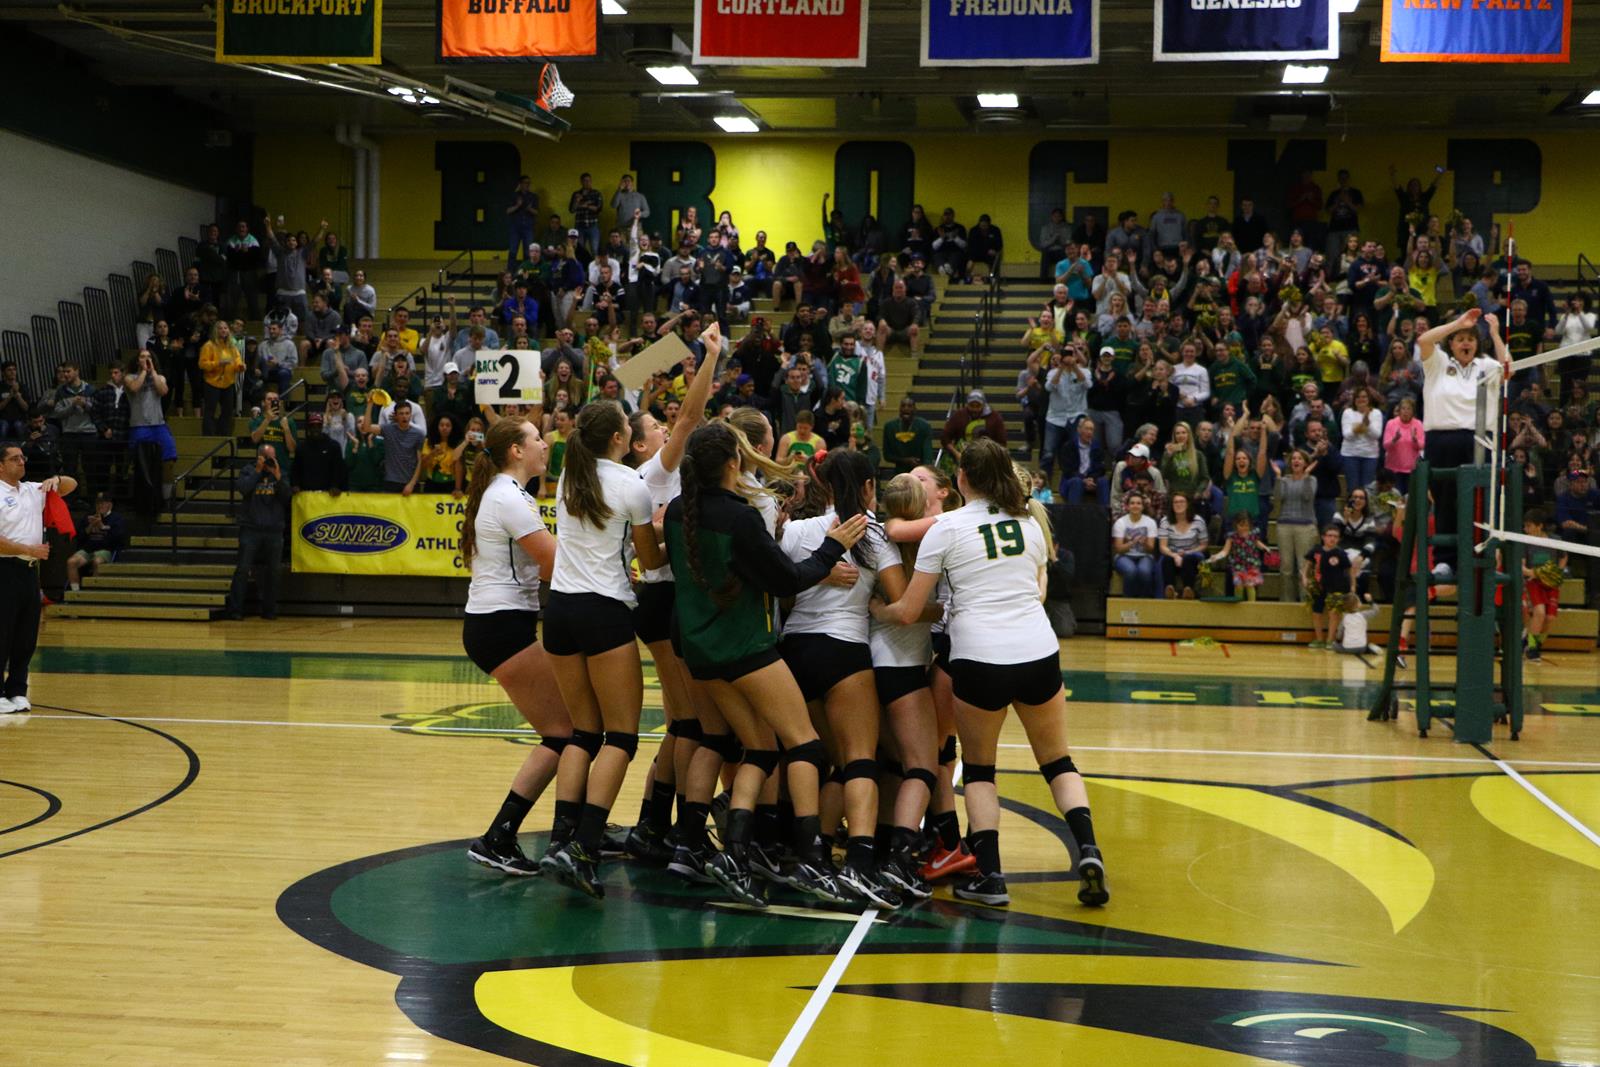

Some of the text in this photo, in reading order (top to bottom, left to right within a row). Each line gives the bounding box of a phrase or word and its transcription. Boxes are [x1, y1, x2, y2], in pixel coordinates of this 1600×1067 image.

[231, 0, 368, 16] BROCKPORT
[467, 0, 571, 14] BUFFALO
[716, 0, 846, 15] CORTLAND
[948, 0, 1073, 16] FREDONIA
[476, 354, 522, 399] BACK 2
[435, 502, 467, 515] STA
[312, 522, 400, 544] SUNYAC
[977, 519, 1025, 560] 19
[415, 537, 462, 550] ATHL
